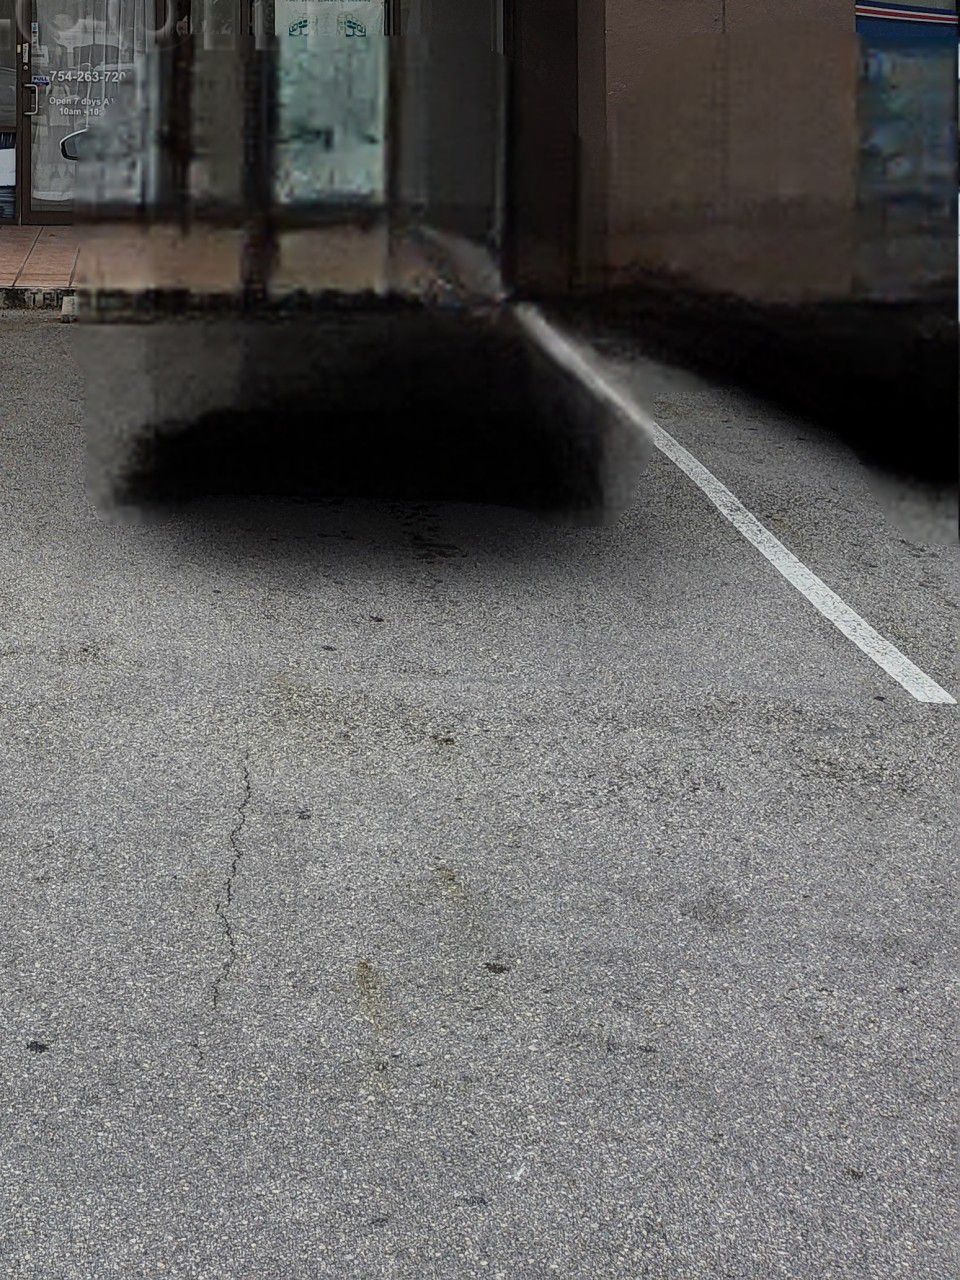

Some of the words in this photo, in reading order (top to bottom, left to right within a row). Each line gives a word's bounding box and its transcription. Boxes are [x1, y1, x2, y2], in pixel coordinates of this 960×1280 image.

[49, 96, 72, 106] Open
[81, 97, 101, 106] days
[60, 107, 82, 115] 10am
